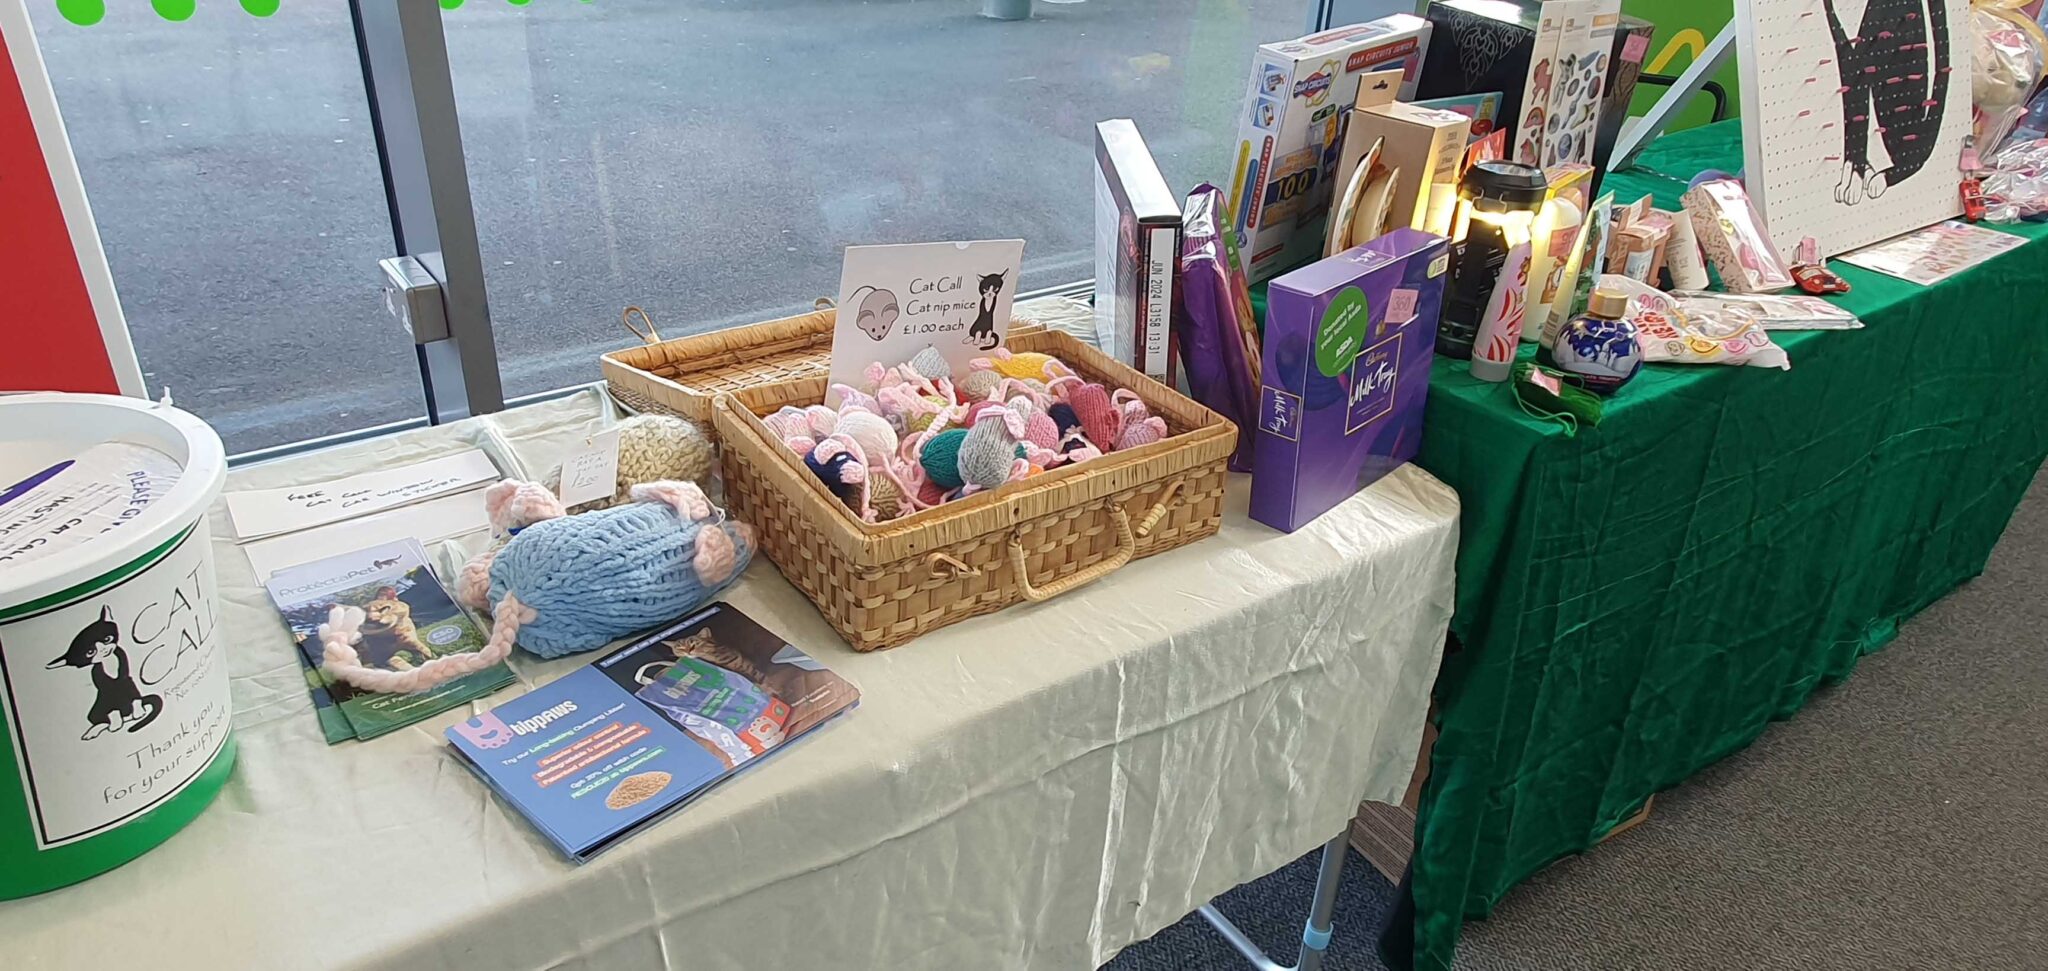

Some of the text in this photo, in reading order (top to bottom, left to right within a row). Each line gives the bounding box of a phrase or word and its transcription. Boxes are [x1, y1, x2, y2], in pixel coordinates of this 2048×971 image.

[1151, 259, 1164, 275] JUN
[909, 275, 964, 295] Cat Call
[1150, 279, 1163, 299] 2024
[905, 299, 976, 317] Cat nip mice
[1149, 303, 1162, 328] L3158
[902, 317, 965, 335] £1.00 each
[1349, 371, 1376, 407] Milk
[1374, 361, 1397, 394] Tray
[127, 470, 151, 506] PLEASE
[131, 559, 204, 645] CAT
[139, 599, 219, 686] CALL
[126, 701, 214, 770] Thank you
[102, 784, 137, 805] for
[140, 754, 183, 794] your
